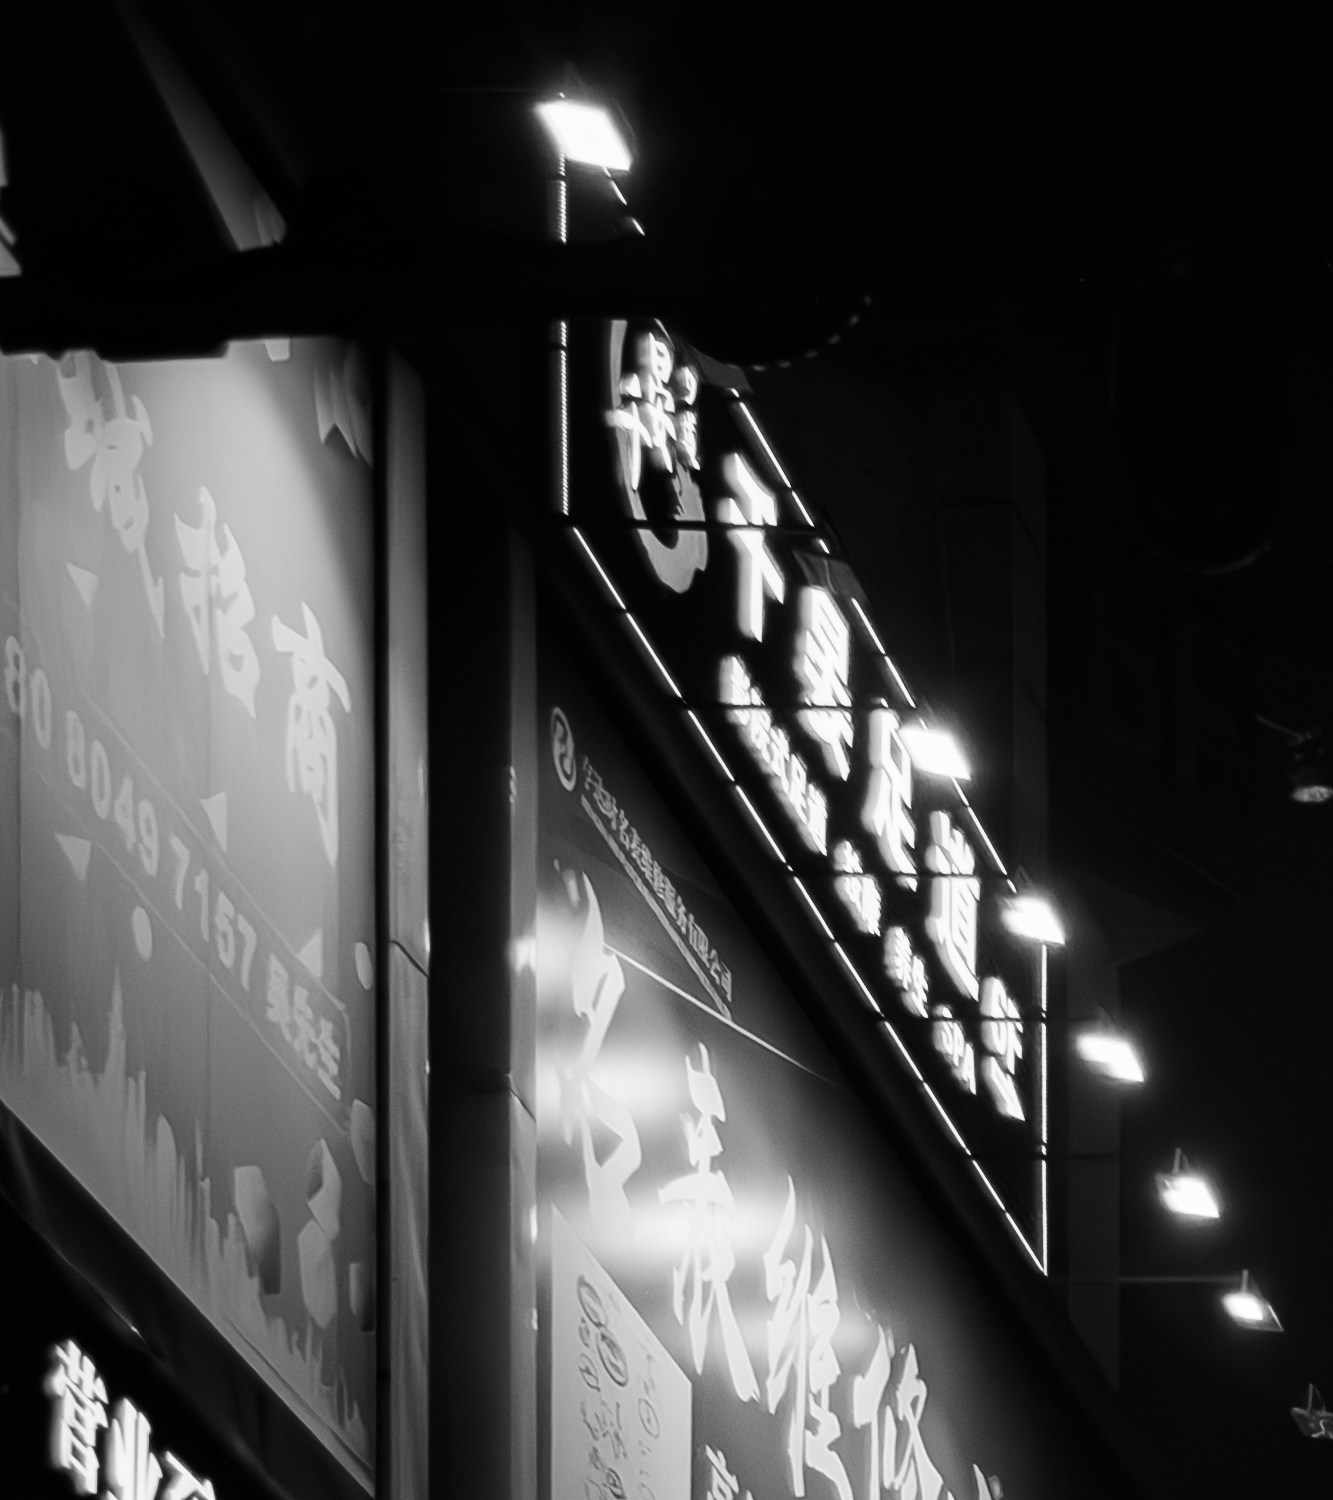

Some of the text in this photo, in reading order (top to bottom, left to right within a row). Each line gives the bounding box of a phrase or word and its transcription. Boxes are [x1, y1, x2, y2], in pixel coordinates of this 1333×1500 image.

[66, 710, 160, 877] 8049
[170, 832, 257, 991] 7157
[933, 1004, 977, 1095] SPA
